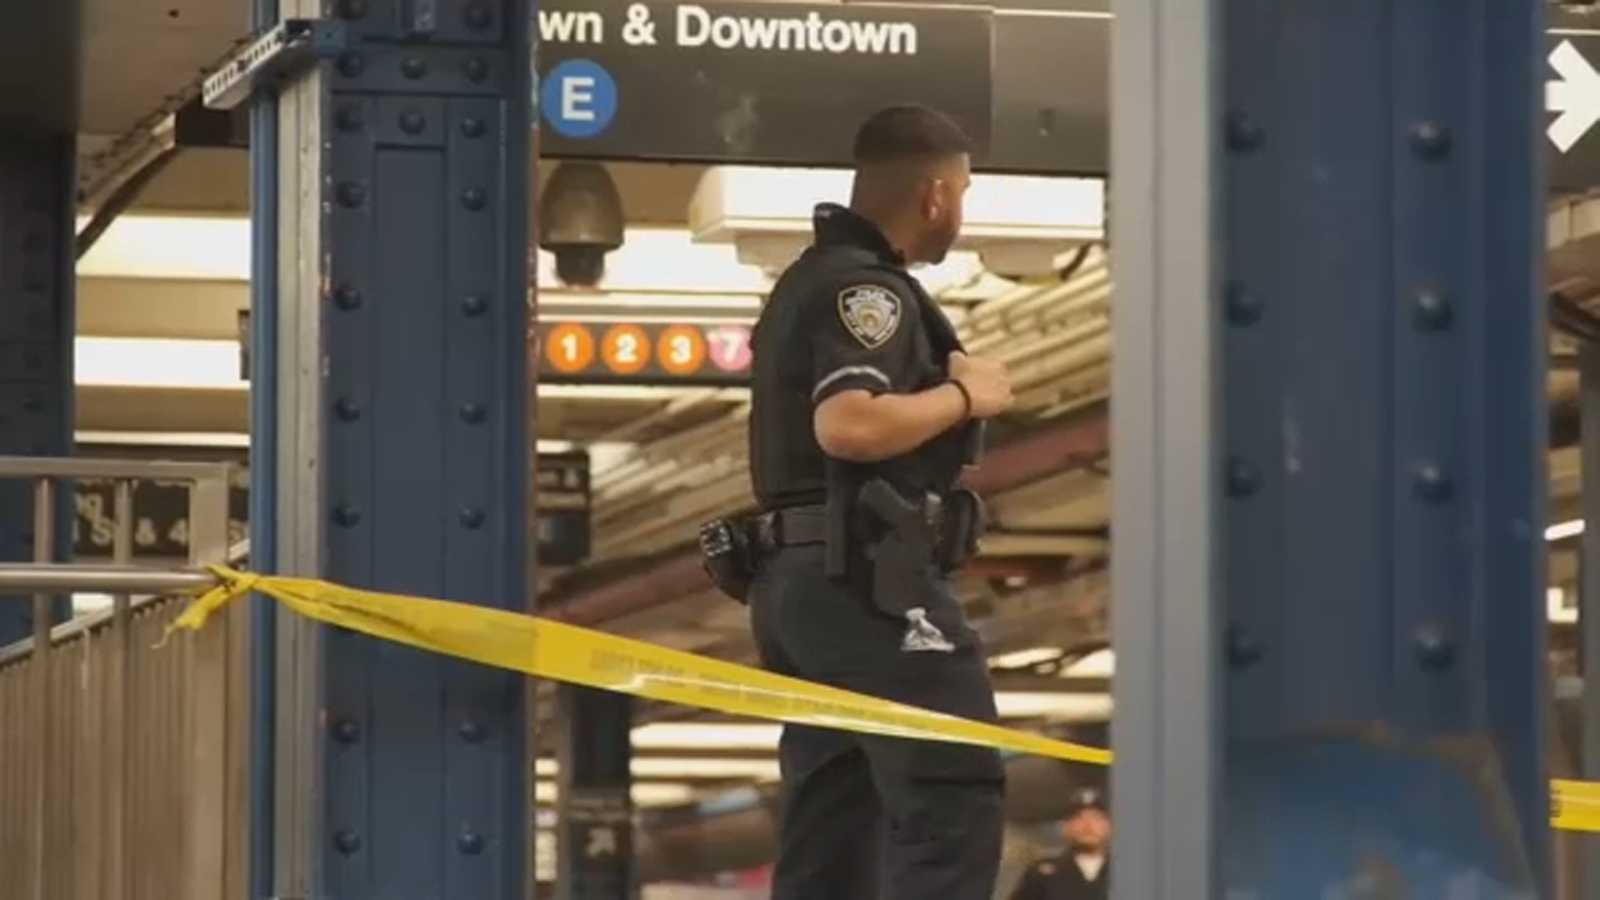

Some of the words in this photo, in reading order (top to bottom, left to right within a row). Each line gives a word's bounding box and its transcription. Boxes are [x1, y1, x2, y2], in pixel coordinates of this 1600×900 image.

[622, 3, 657, 45] &
[676, 5, 917, 54] Downtown
[561, 77, 595, 121] E
[561, 333, 577, 361] 1
[615, 333, 638, 363] 2
[669, 334, 692, 364] 3
[719, 331, 741, 361] 7
